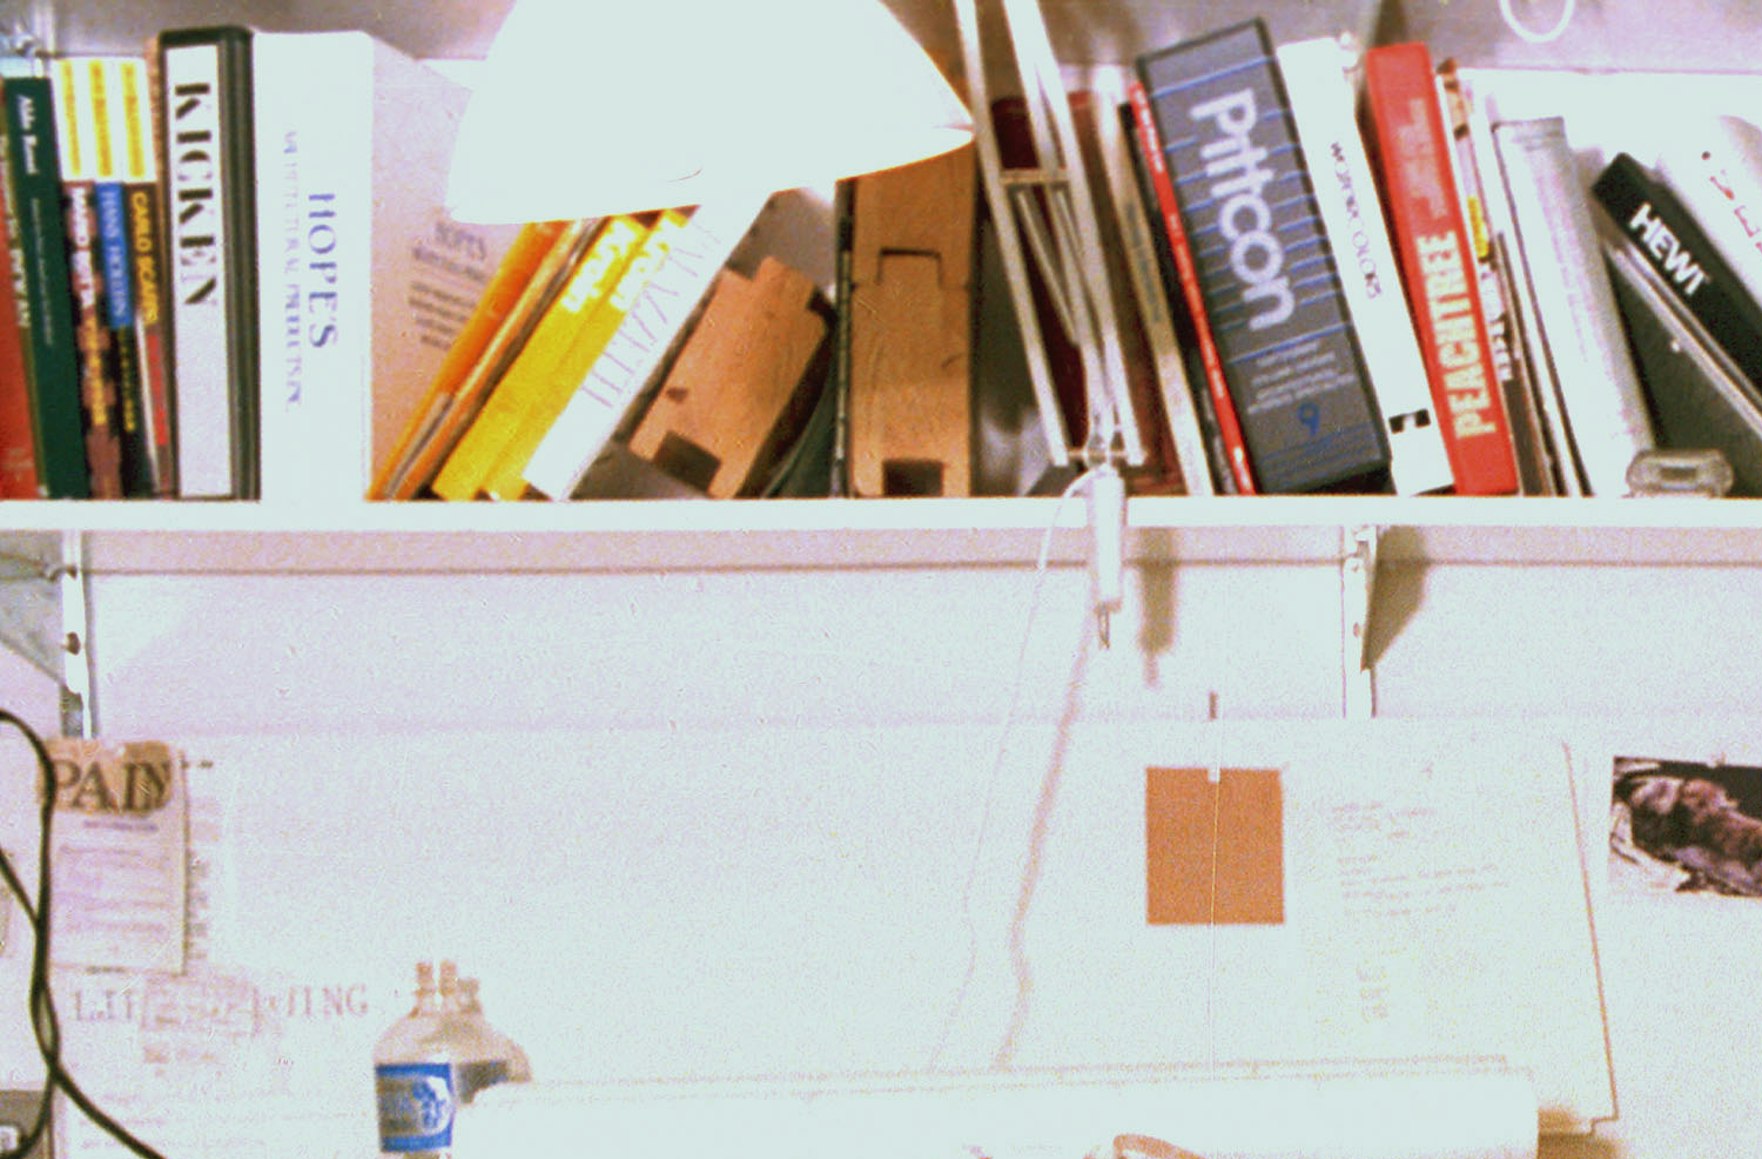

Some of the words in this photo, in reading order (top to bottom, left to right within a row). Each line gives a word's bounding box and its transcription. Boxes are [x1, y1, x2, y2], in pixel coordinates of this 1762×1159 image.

[174, 82, 217, 306] KICKEN
[308, 193, 338, 348] HOPE'S
[1191, 87, 1296, 331] Pittcon
[1627, 203, 1707, 296] HEWI
[1417, 230, 1496, 440] PEACHTREE
